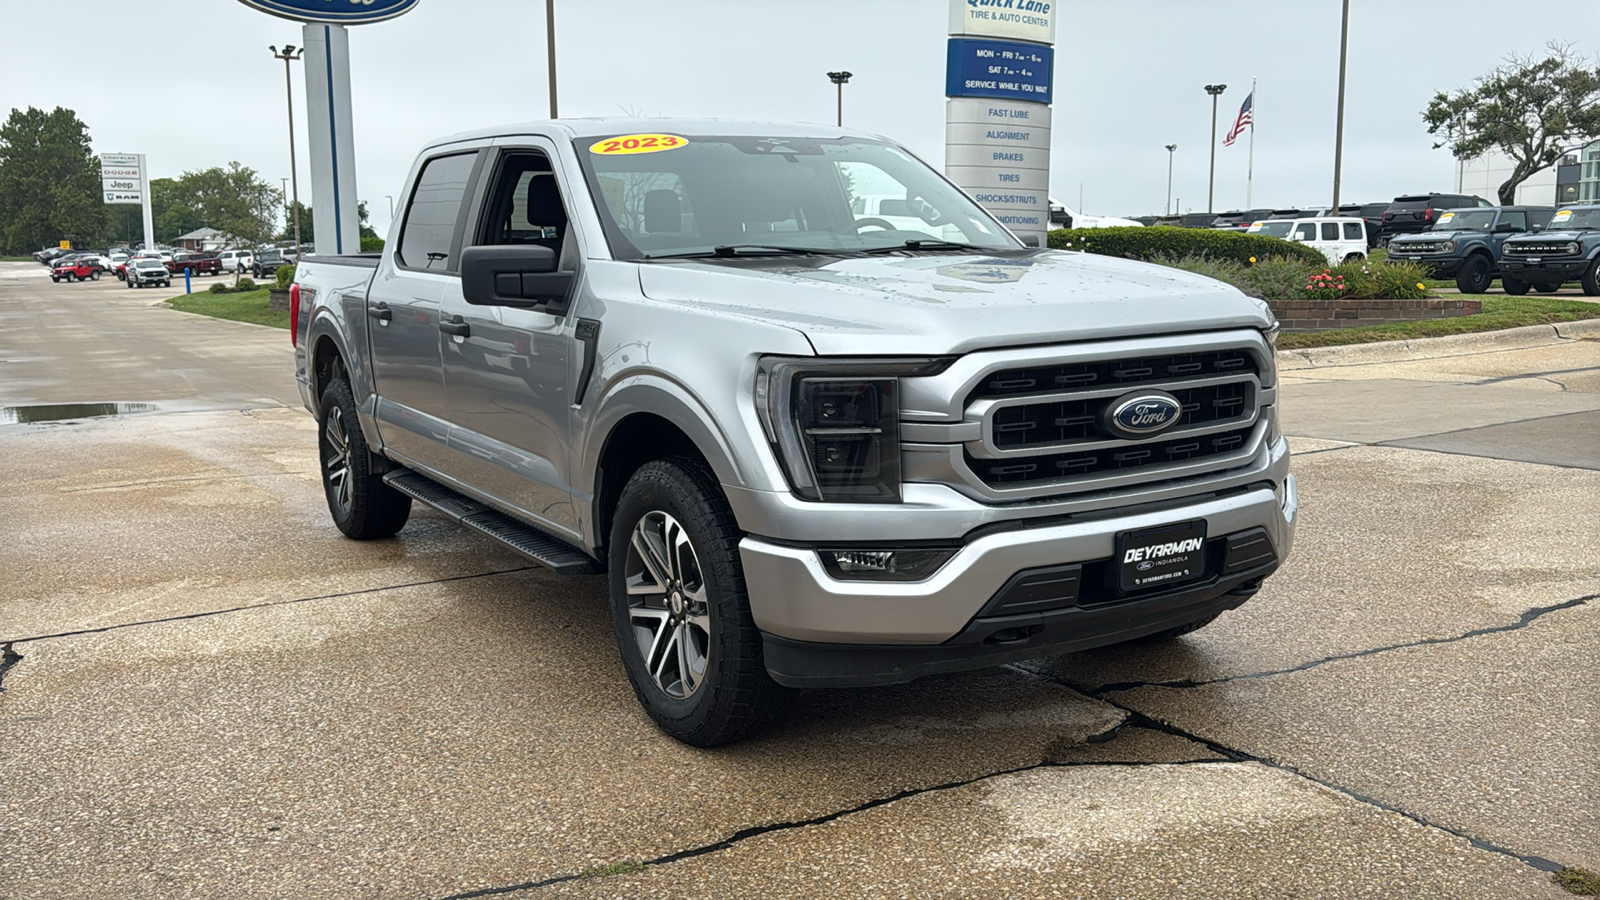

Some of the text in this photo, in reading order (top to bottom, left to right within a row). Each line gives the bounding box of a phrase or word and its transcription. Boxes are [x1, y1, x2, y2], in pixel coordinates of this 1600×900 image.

[1016, 0, 1050, 14] Lane
[970, 10, 1049, 27] TIRE & AUTO CENTER
[976, 49, 994, 58] MON
[1002, 51, 1013, 59] FRI
[988, 65, 1002, 74] SAT
[965, 80, 1047, 94] SERVICE WHILE YOU WAIT
[988, 108, 1029, 119] FAST LUBE
[986, 130, 1030, 141] ALIGNMENT
[603, 136, 679, 153] 2023
[993, 152, 1024, 162] BRAKES
[998, 174, 1020, 182] TIRES
[110, 180, 133, 189] Jeep
[975, 194, 1037, 204] SHOCKS/STRUTS
[1131, 404, 1167, 425] Ford
[1123, 537, 1203, 564] DEYARMAN
[1155, 555, 1189, 566] INDIANOLA
